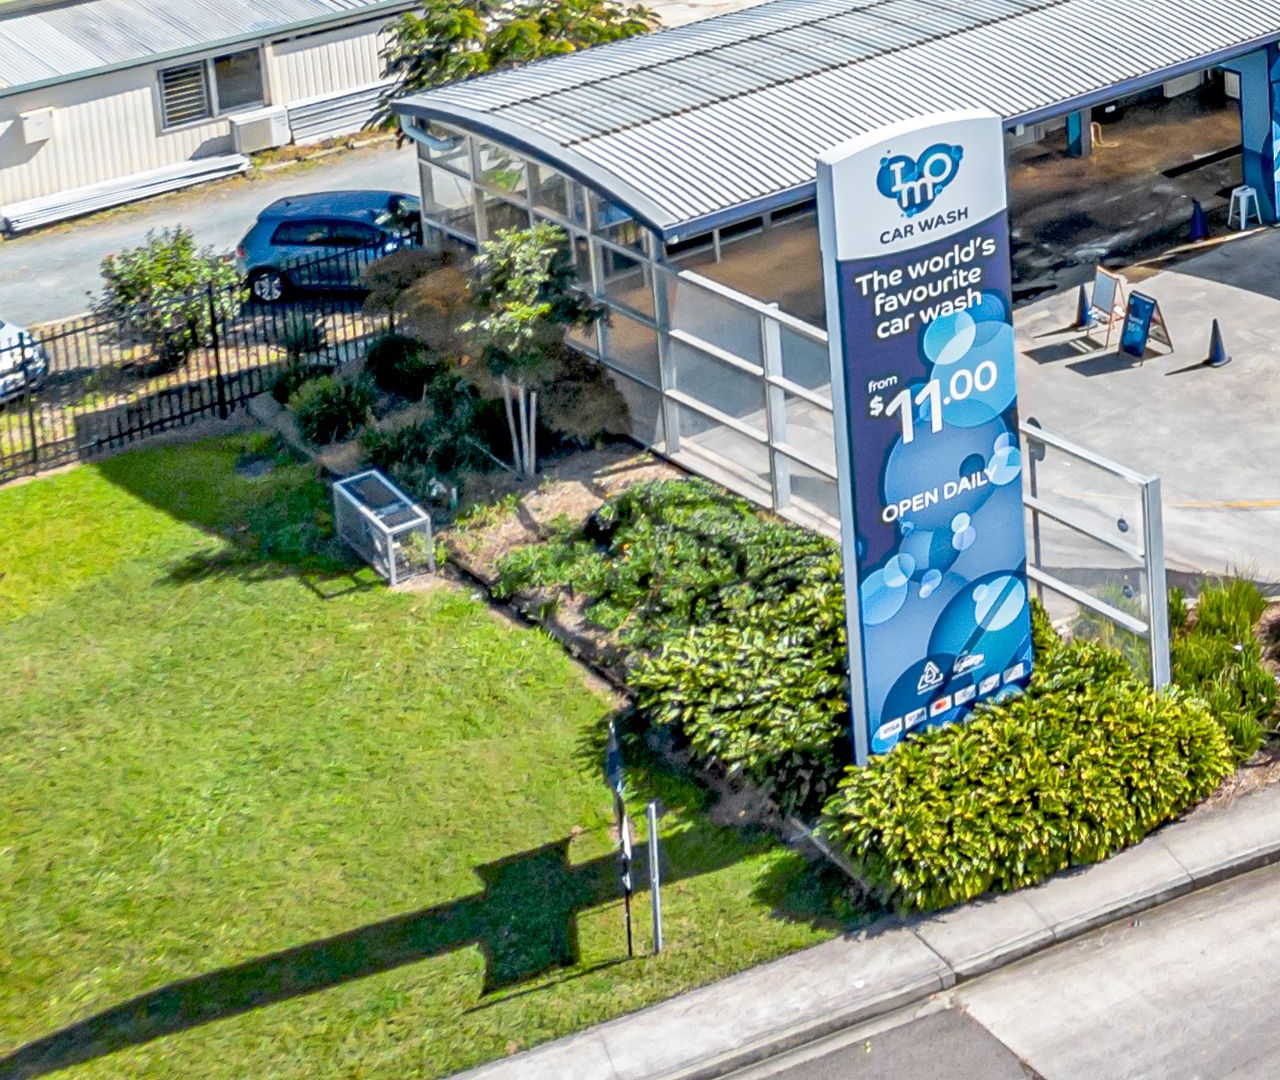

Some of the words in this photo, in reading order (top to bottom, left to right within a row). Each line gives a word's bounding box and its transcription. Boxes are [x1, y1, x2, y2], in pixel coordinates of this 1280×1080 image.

[879, 224, 914, 245] CAR
[917, 206, 969, 236] WASH
[855, 269, 903, 297] The
[907, 236, 997, 280] world's
[873, 267, 982, 316] favourite
[875, 313, 914, 339] car
[919, 288, 983, 324] wash
[868, 374, 898, 394] from
[882, 487, 939, 523] OPEN
[943, 466, 997, 500] DAILY
